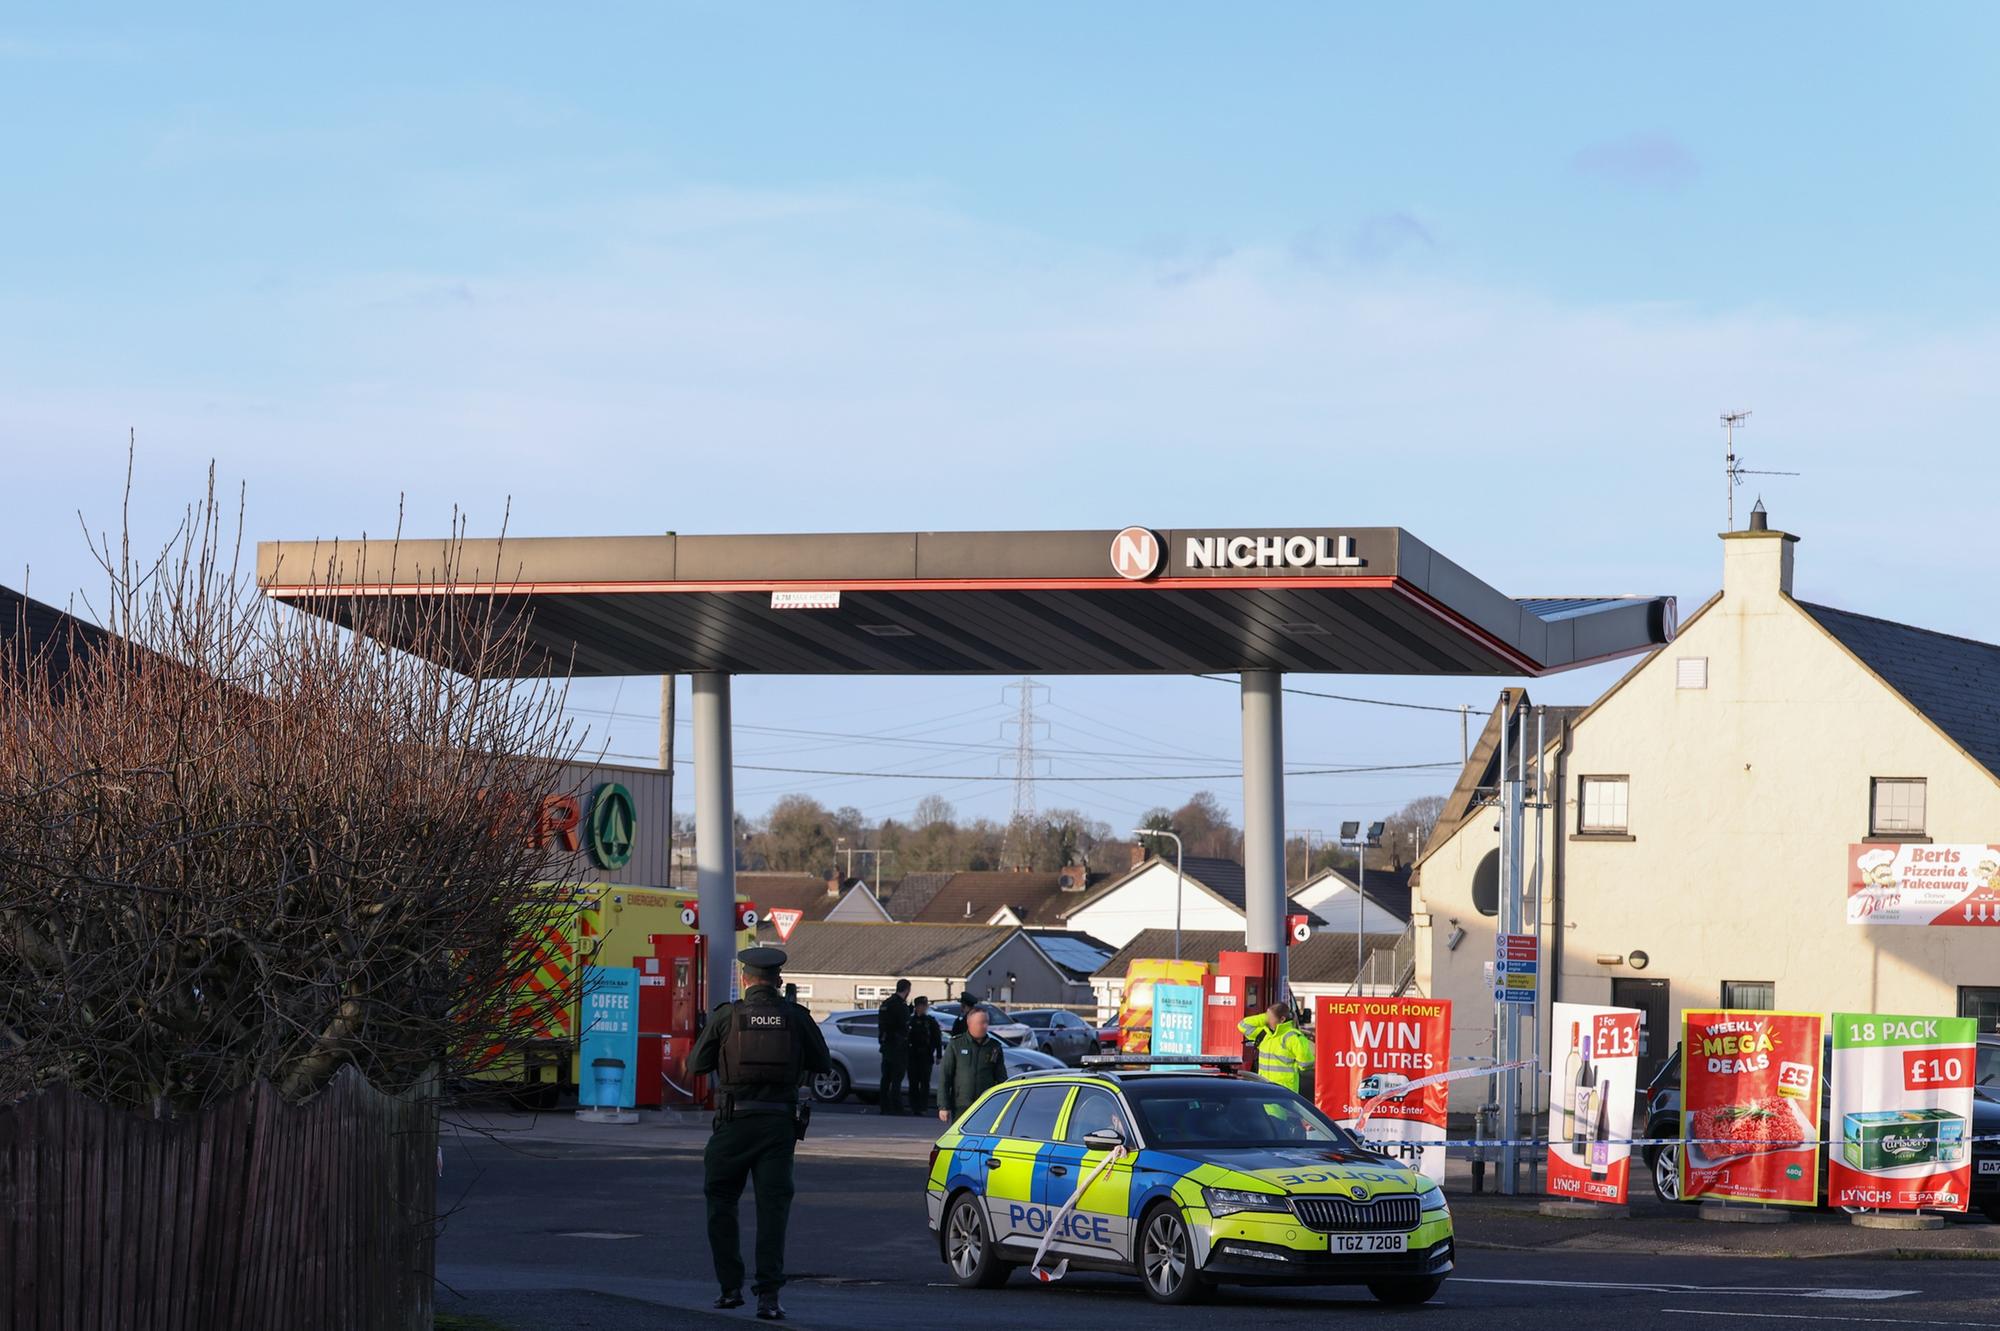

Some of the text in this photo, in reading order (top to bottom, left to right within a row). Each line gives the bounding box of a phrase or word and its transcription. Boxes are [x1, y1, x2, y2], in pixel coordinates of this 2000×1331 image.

[1119, 535, 1360, 570] N NICHOLL
[1911, 848, 1961, 863] Berts
[1903, 865, 1968, 877] Pizzeria &
[1901, 879, 1969, 892] Takeaway
[627, 894, 668, 907] EMERGENCY
[1857, 893, 1901, 918] Berts
[748, 914, 755, 923] 2
[776, 913, 794, 921] GIVE
[648, 935, 653, 943] 1
[694, 935, 700, 943] 2
[1298, 927, 1305, 937] 4
[592, 993, 629, 1009] COFFEE
[594, 1011, 609, 1019] AS
[1329, 1003, 1441, 1016] HEAT YOUR HOME
[751, 1016, 781, 1025] POLICE
[1160, 1012, 1193, 1030] COFFEE
[1604, 1017, 1616, 1026] For
[1162, 1031, 1175, 1039] AS
[1349, 1021, 1421, 1049] WIN
[1706, 1021, 1763, 1036] WEEKLY
[1850, 1020, 1938, 1042] 18 PACK
[1597, 1027, 1634, 1054] £13
[1703, 1034, 1774, 1057] MEGA
[1335, 1051, 1434, 1069] 100 LITRES
[1707, 1053, 1770, 1074] DEALS
[1780, 1067, 1809, 1087] £5
[1911, 1058, 1962, 1083] £10
[1343, 1104, 1365, 1114] Spen
[1389, 1105, 1399, 1114] To
[1401, 1106, 1424, 1114] Enter
[1881, 1133, 1929, 1153] Carlsberg
[1587, 1184, 1608, 1195] SPAR
[1908, 1193, 1942, 1203] SPAR
[1009, 1203, 1112, 1244] POLICE
[1337, 1236, 1402, 1251] TGZ 7208
